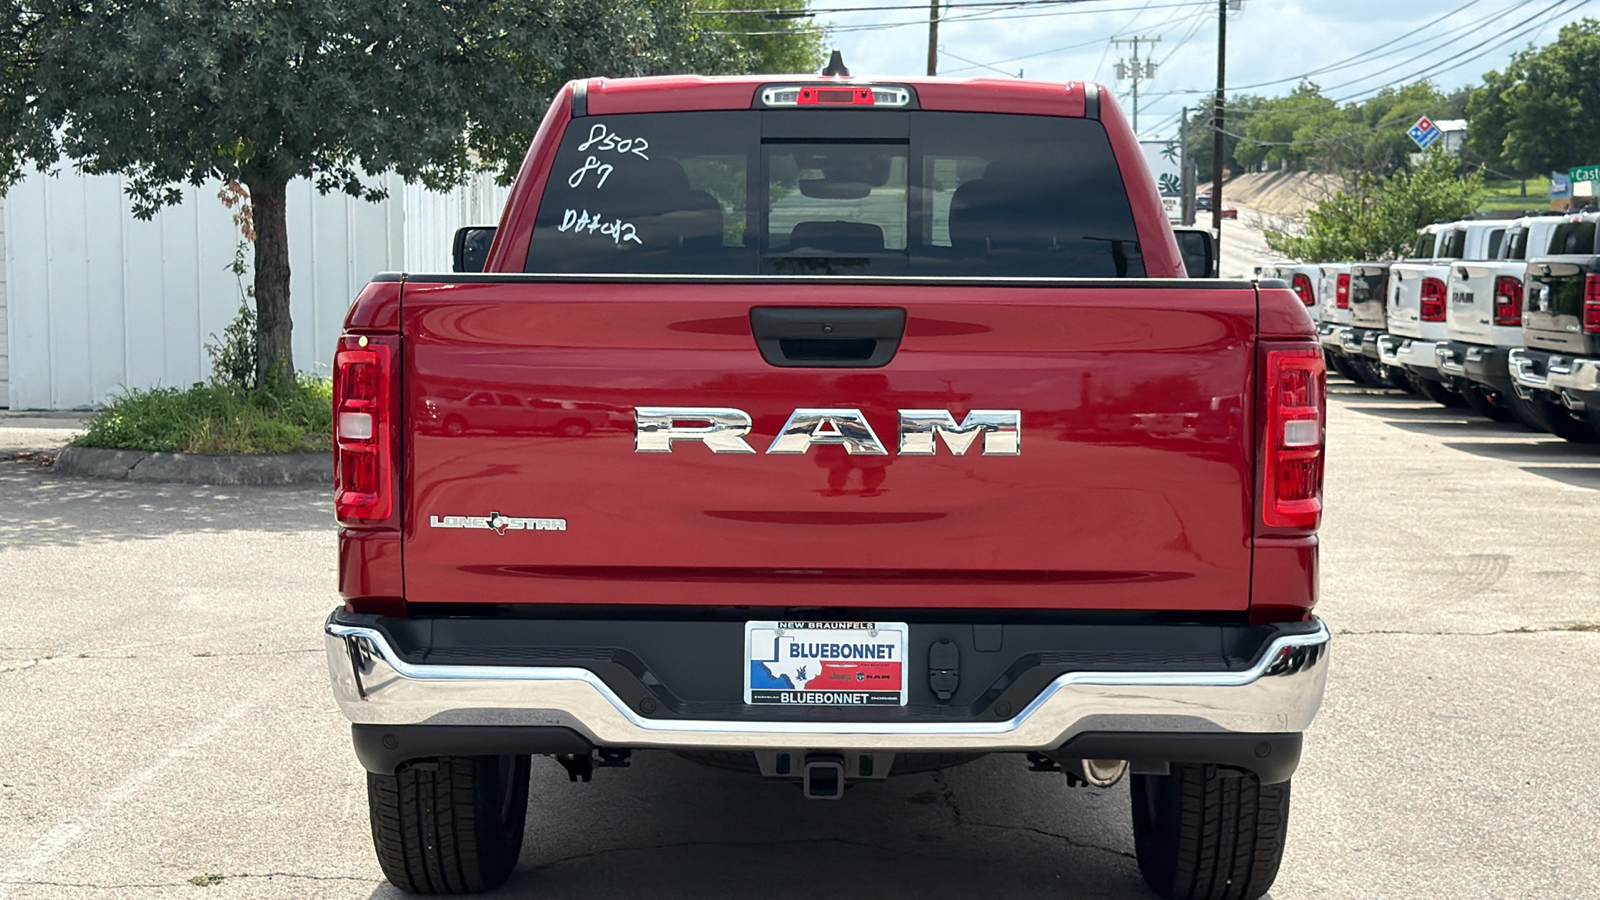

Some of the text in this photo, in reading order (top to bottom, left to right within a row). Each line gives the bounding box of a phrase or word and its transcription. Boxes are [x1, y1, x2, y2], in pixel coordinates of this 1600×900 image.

[578, 124, 649, 160] 8502
[1575, 167, 1600, 181] Cast
[1452, 292, 1475, 304] RAM
[634, 406, 1021, 455] RAM
[430, 515, 567, 531] LONE STAR
[808, 622, 874, 630] BRAUNFELS
[789, 643, 895, 659] BLUEBONNET
[780, 692, 869, 704] BLUEBONNET
